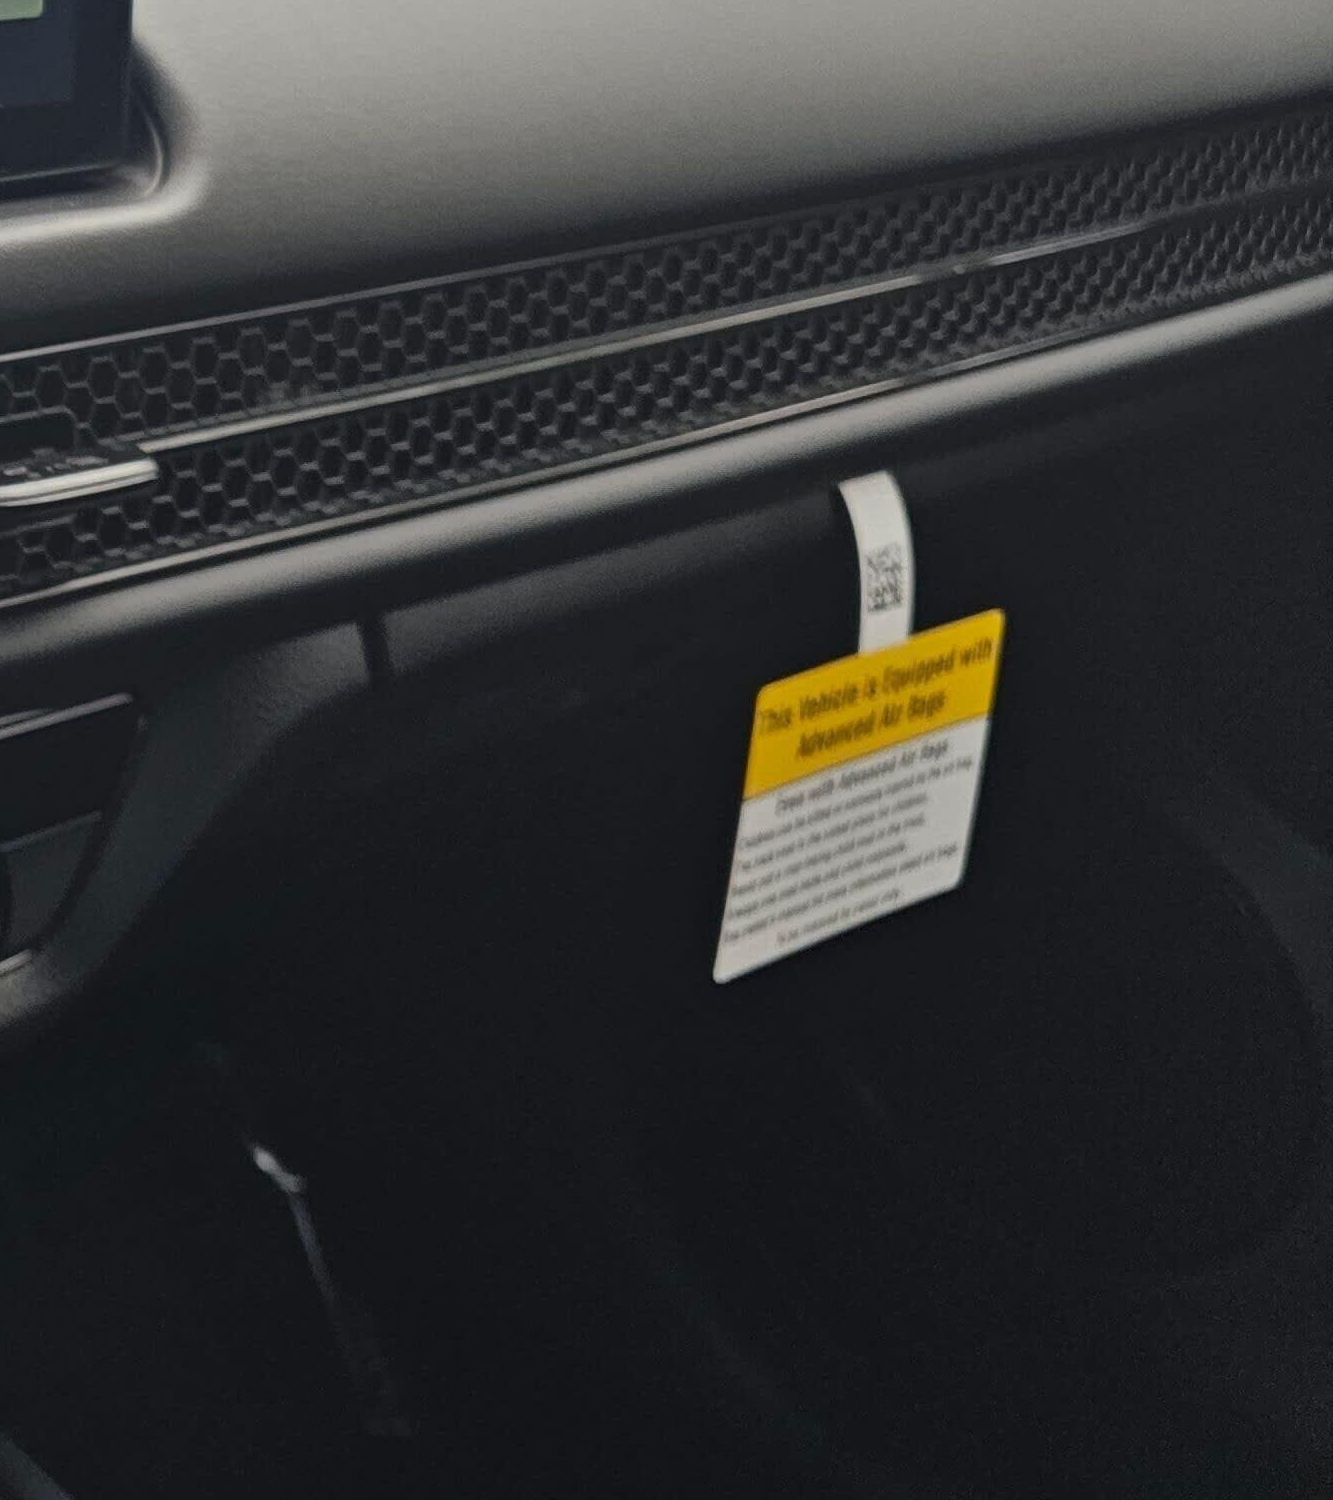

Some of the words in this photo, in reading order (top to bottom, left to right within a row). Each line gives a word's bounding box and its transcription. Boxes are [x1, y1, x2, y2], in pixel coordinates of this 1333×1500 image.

[799, 682, 858, 722] Vehicle
[864, 674, 877, 700] is
[883, 646, 955, 695] Equipped
[960, 636, 993, 667] with
[796, 707, 877, 758] Advanced
[880, 701, 903, 729] Air
